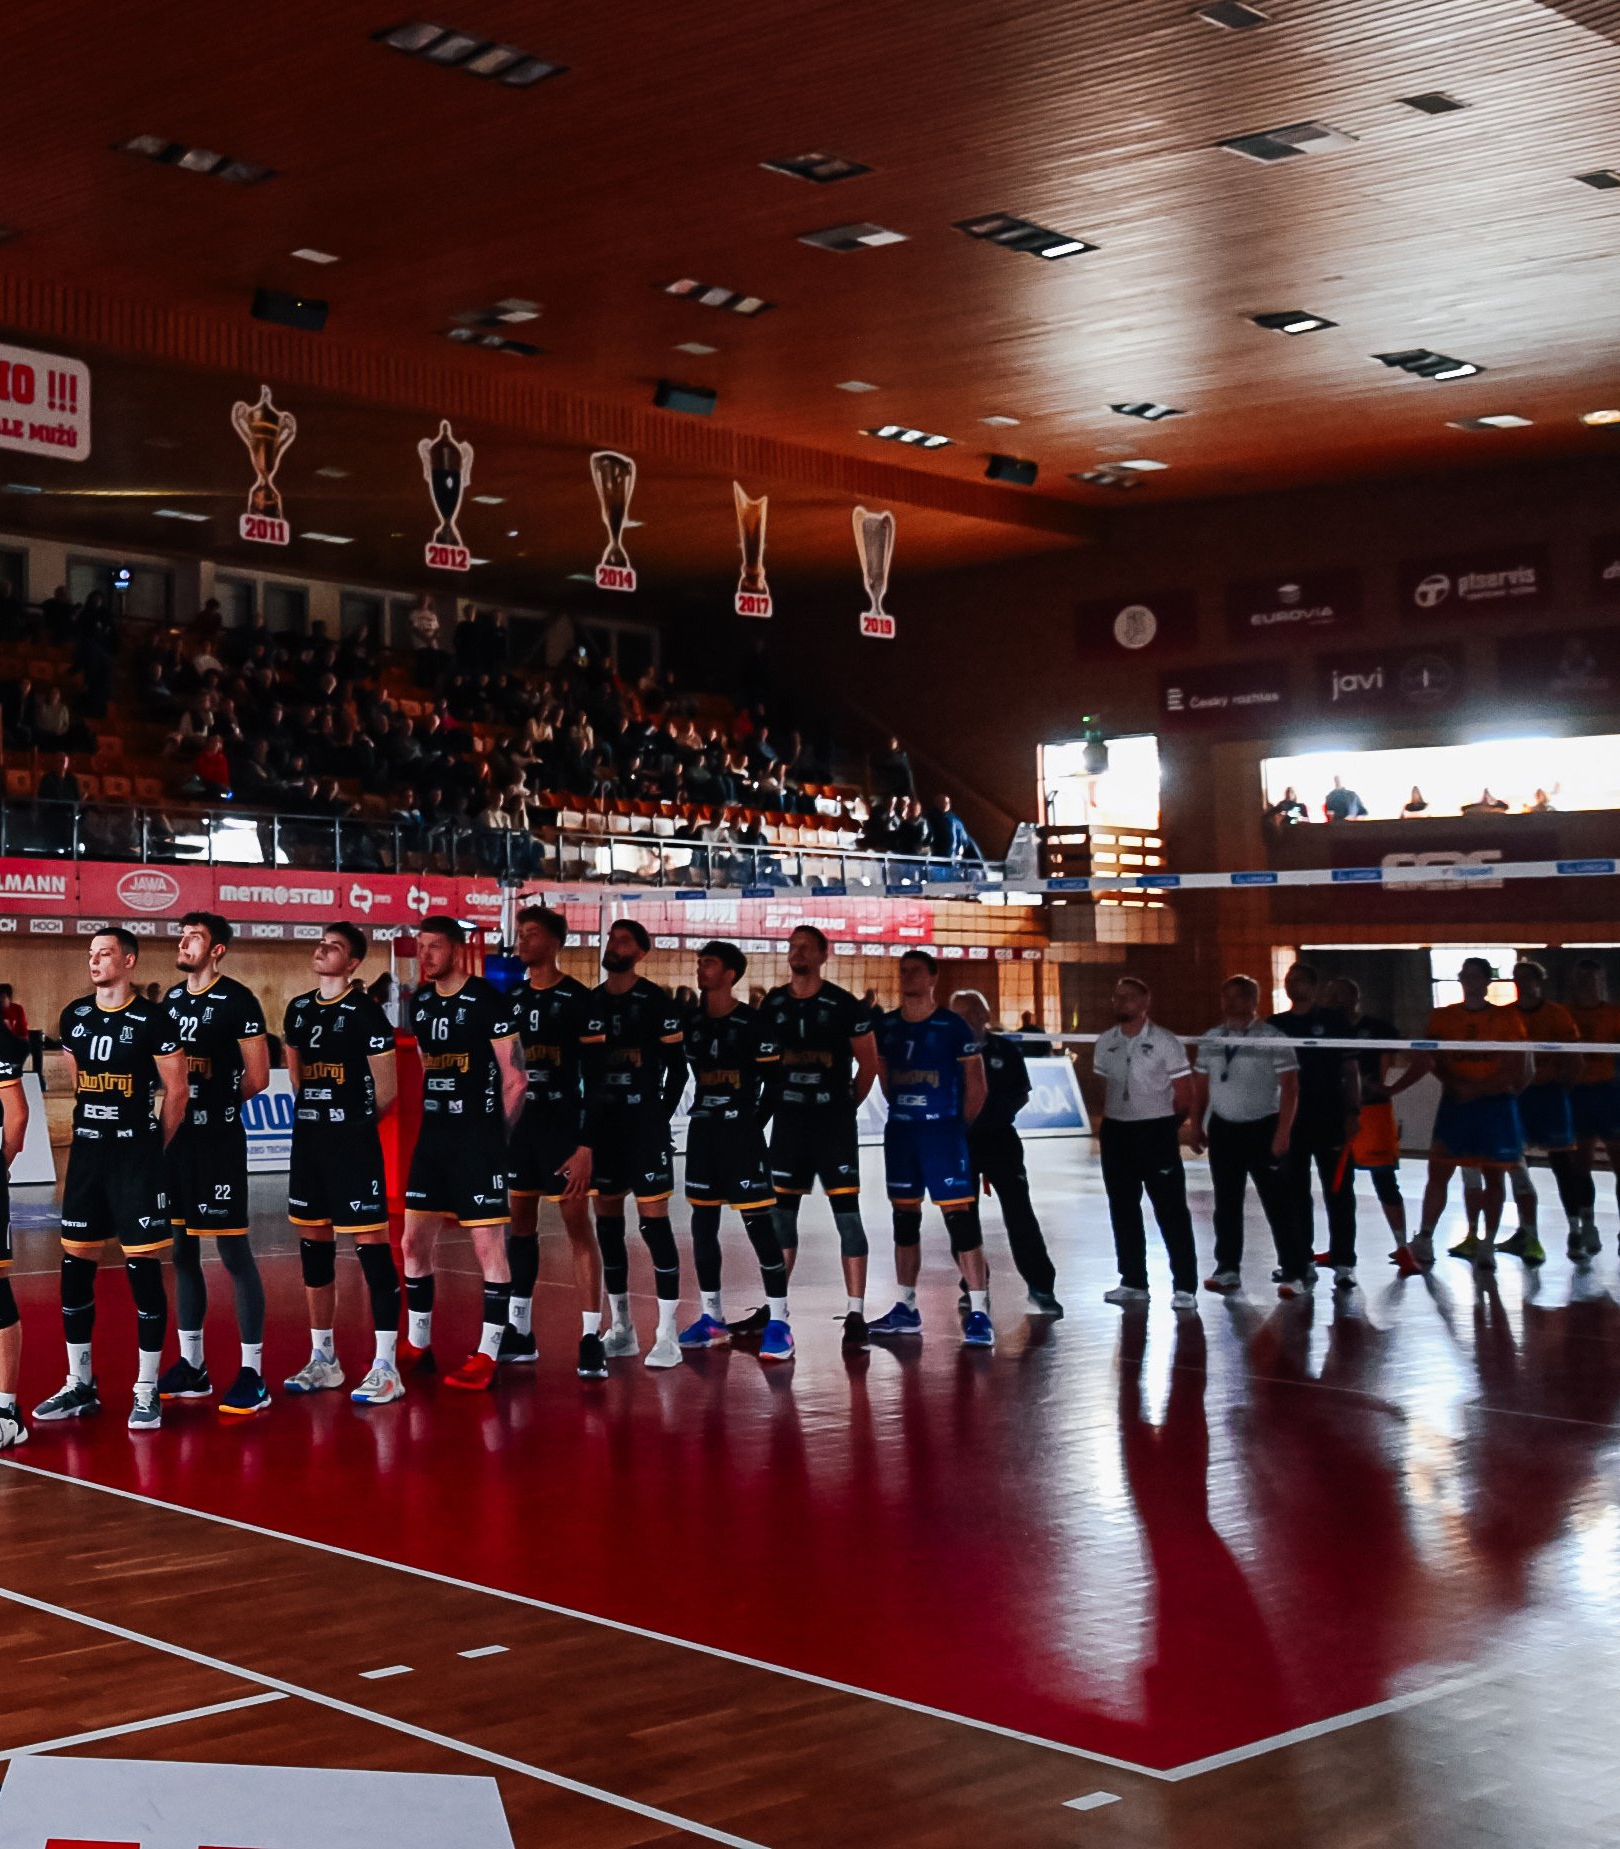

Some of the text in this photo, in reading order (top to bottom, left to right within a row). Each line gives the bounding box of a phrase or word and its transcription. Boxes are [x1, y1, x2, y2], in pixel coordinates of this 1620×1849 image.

[46, 369, 79, 414] !!!
[244, 516, 288, 543] 2011
[427, 547, 469, 569] 2012
[598, 569, 635, 590] 2014
[737, 594, 770, 615] 2017
[1250, 605, 1335, 626] EUROVIA
[863, 616, 893, 637] 2019
[1333, 666, 1384, 702] javi
[130, 876, 168, 892] JAWA
[33, 920, 61, 932] HOCH
[122, 920, 156, 935] HOCH
[252, 923, 284, 937] HOCH
[179, 1016, 198, 1042] 22
[431, 1017, 449, 1041] 16
[529, 1009, 540, 1032] 9
[309, 1025, 323, 1048] 2
[89, 1035, 113, 1062] 10
[709, 1038, 719, 1058] 4
[905, 1040, 915, 1061] 7
[427, 1078, 455, 1091] EGE
[83, 1103, 119, 1120] EGE
[214, 1184, 231, 1201] 22
[371, 1181, 379, 1196] 2
[492, 1174, 504, 1190] 16
[156, 1191, 166, 1209] 10
